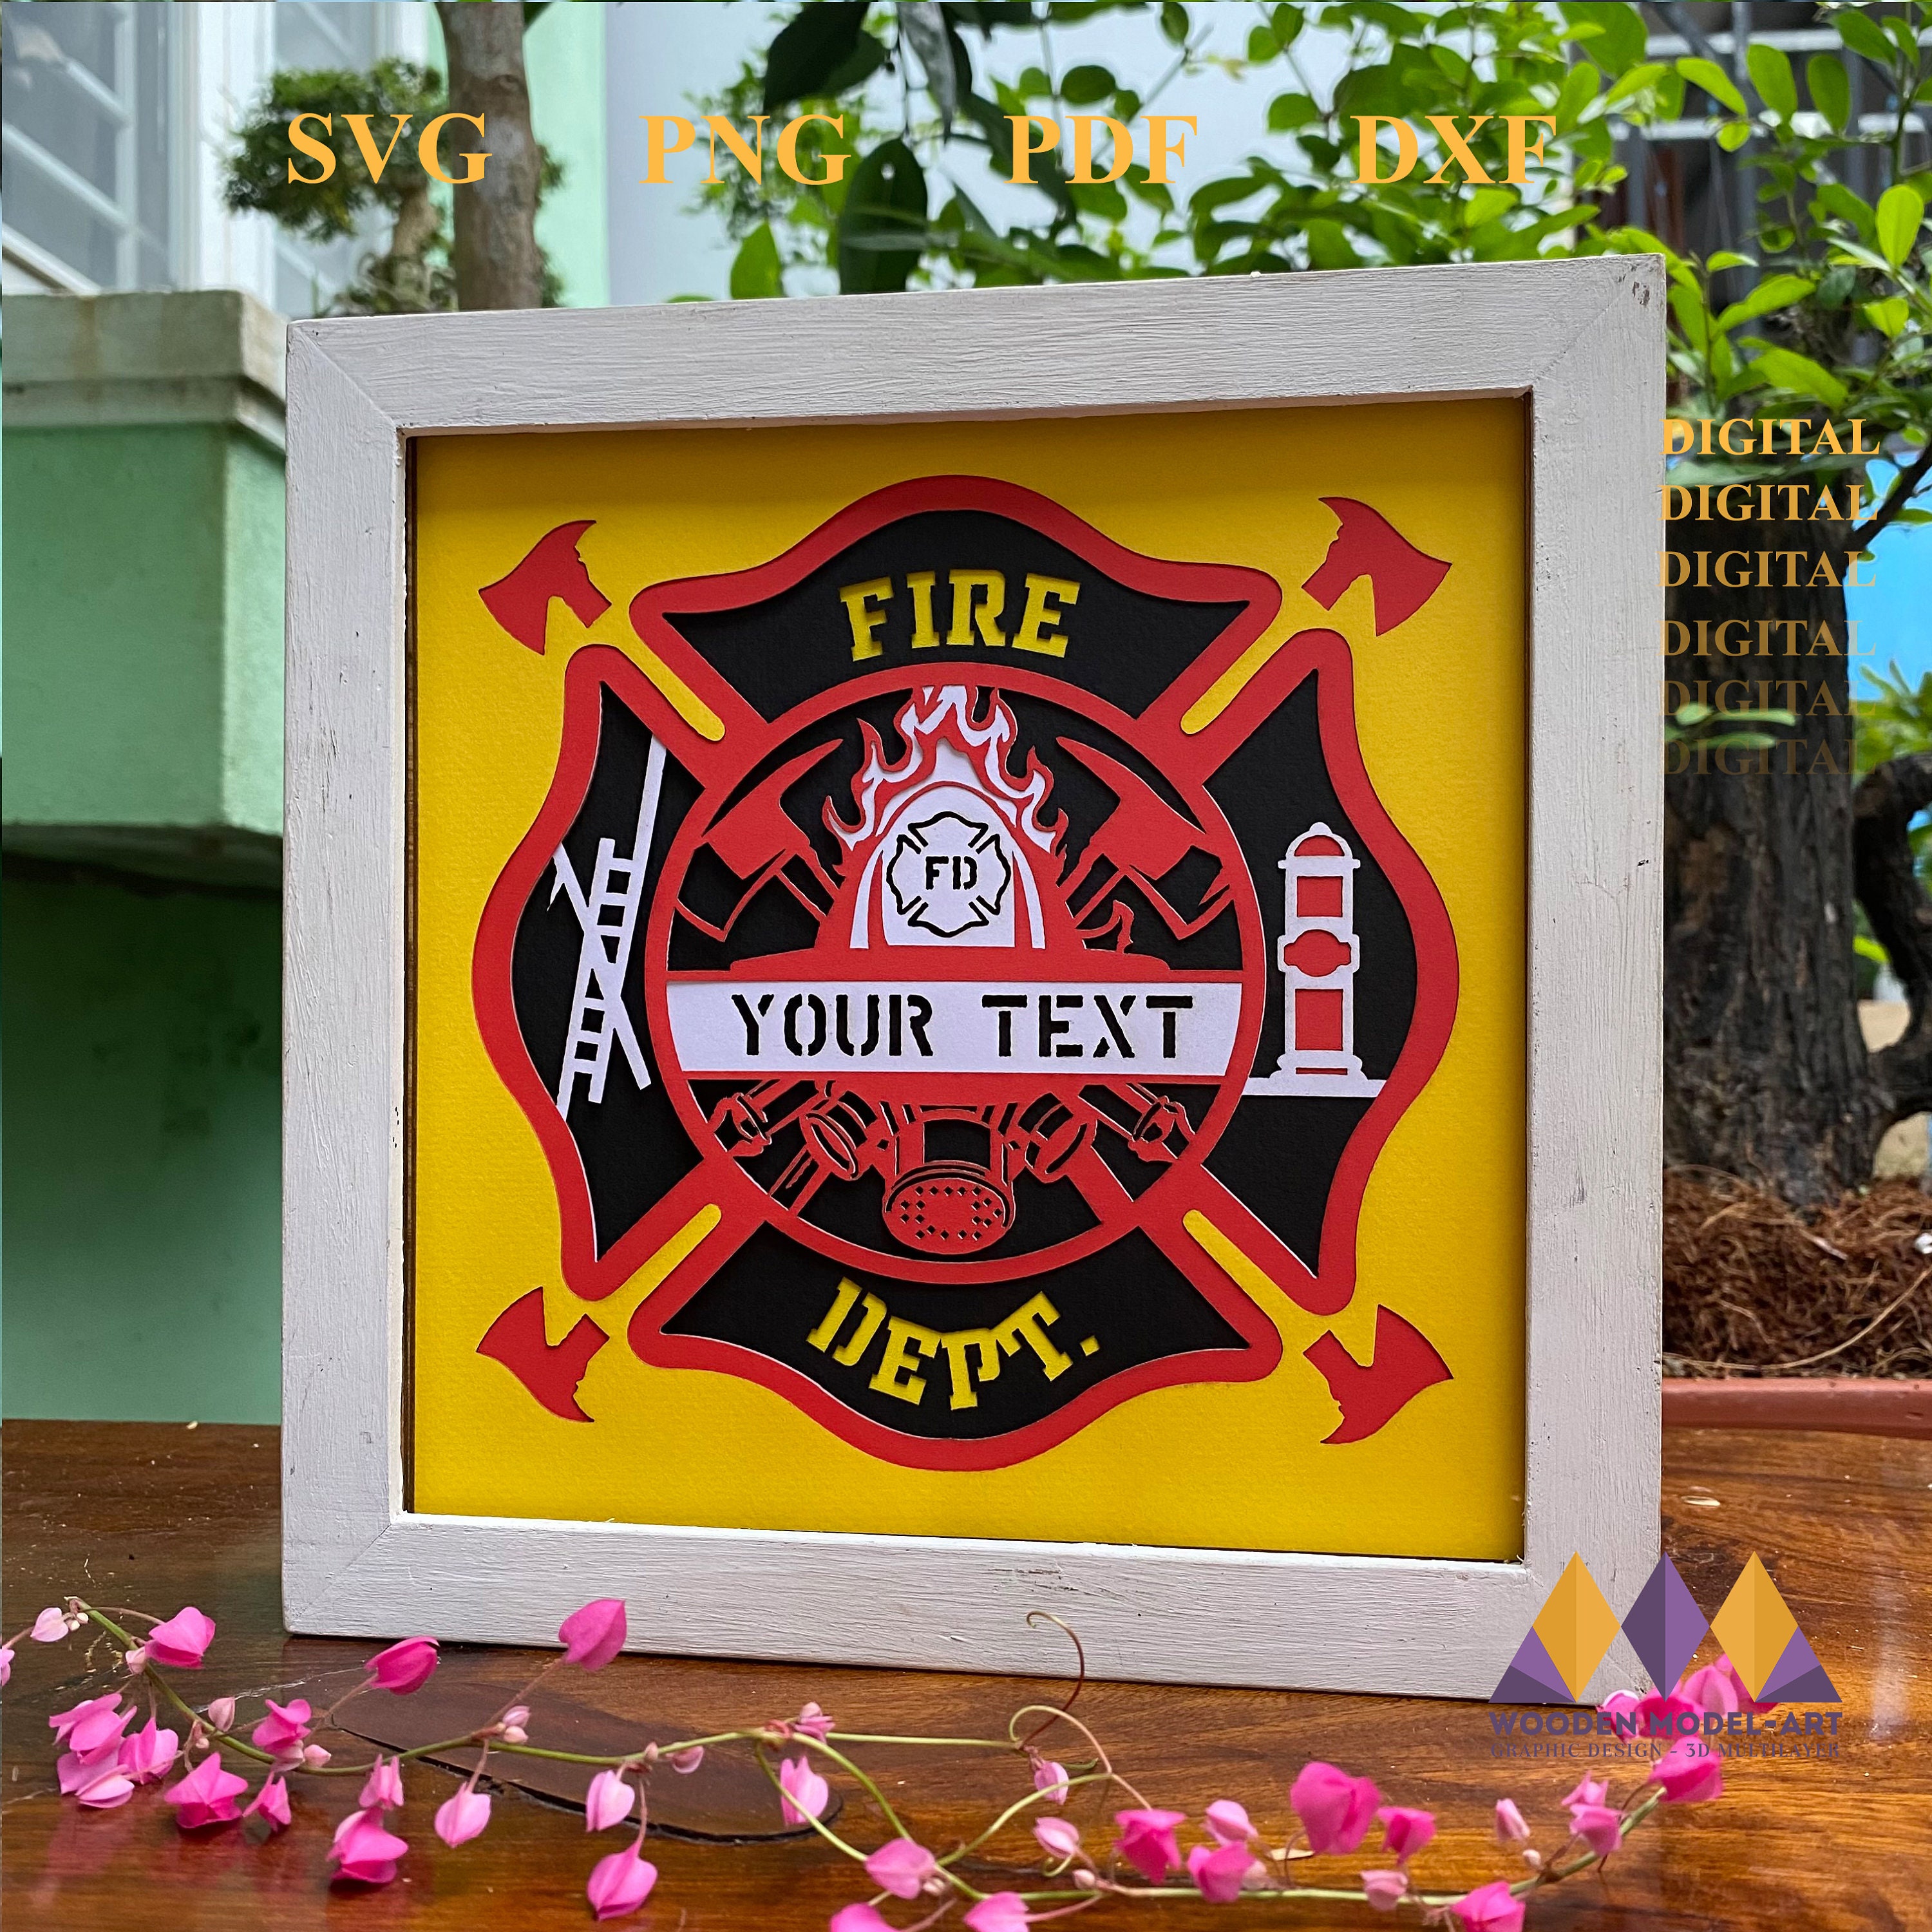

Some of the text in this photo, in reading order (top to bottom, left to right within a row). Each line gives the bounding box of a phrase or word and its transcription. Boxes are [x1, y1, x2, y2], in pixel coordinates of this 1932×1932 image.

[839, 569, 1081, 661] FIRE
[925, 855, 978, 891] FD
[732, 994, 1193, 1059] YOUR TEXT
[806, 1276, 1100, 1411] DEPT.
